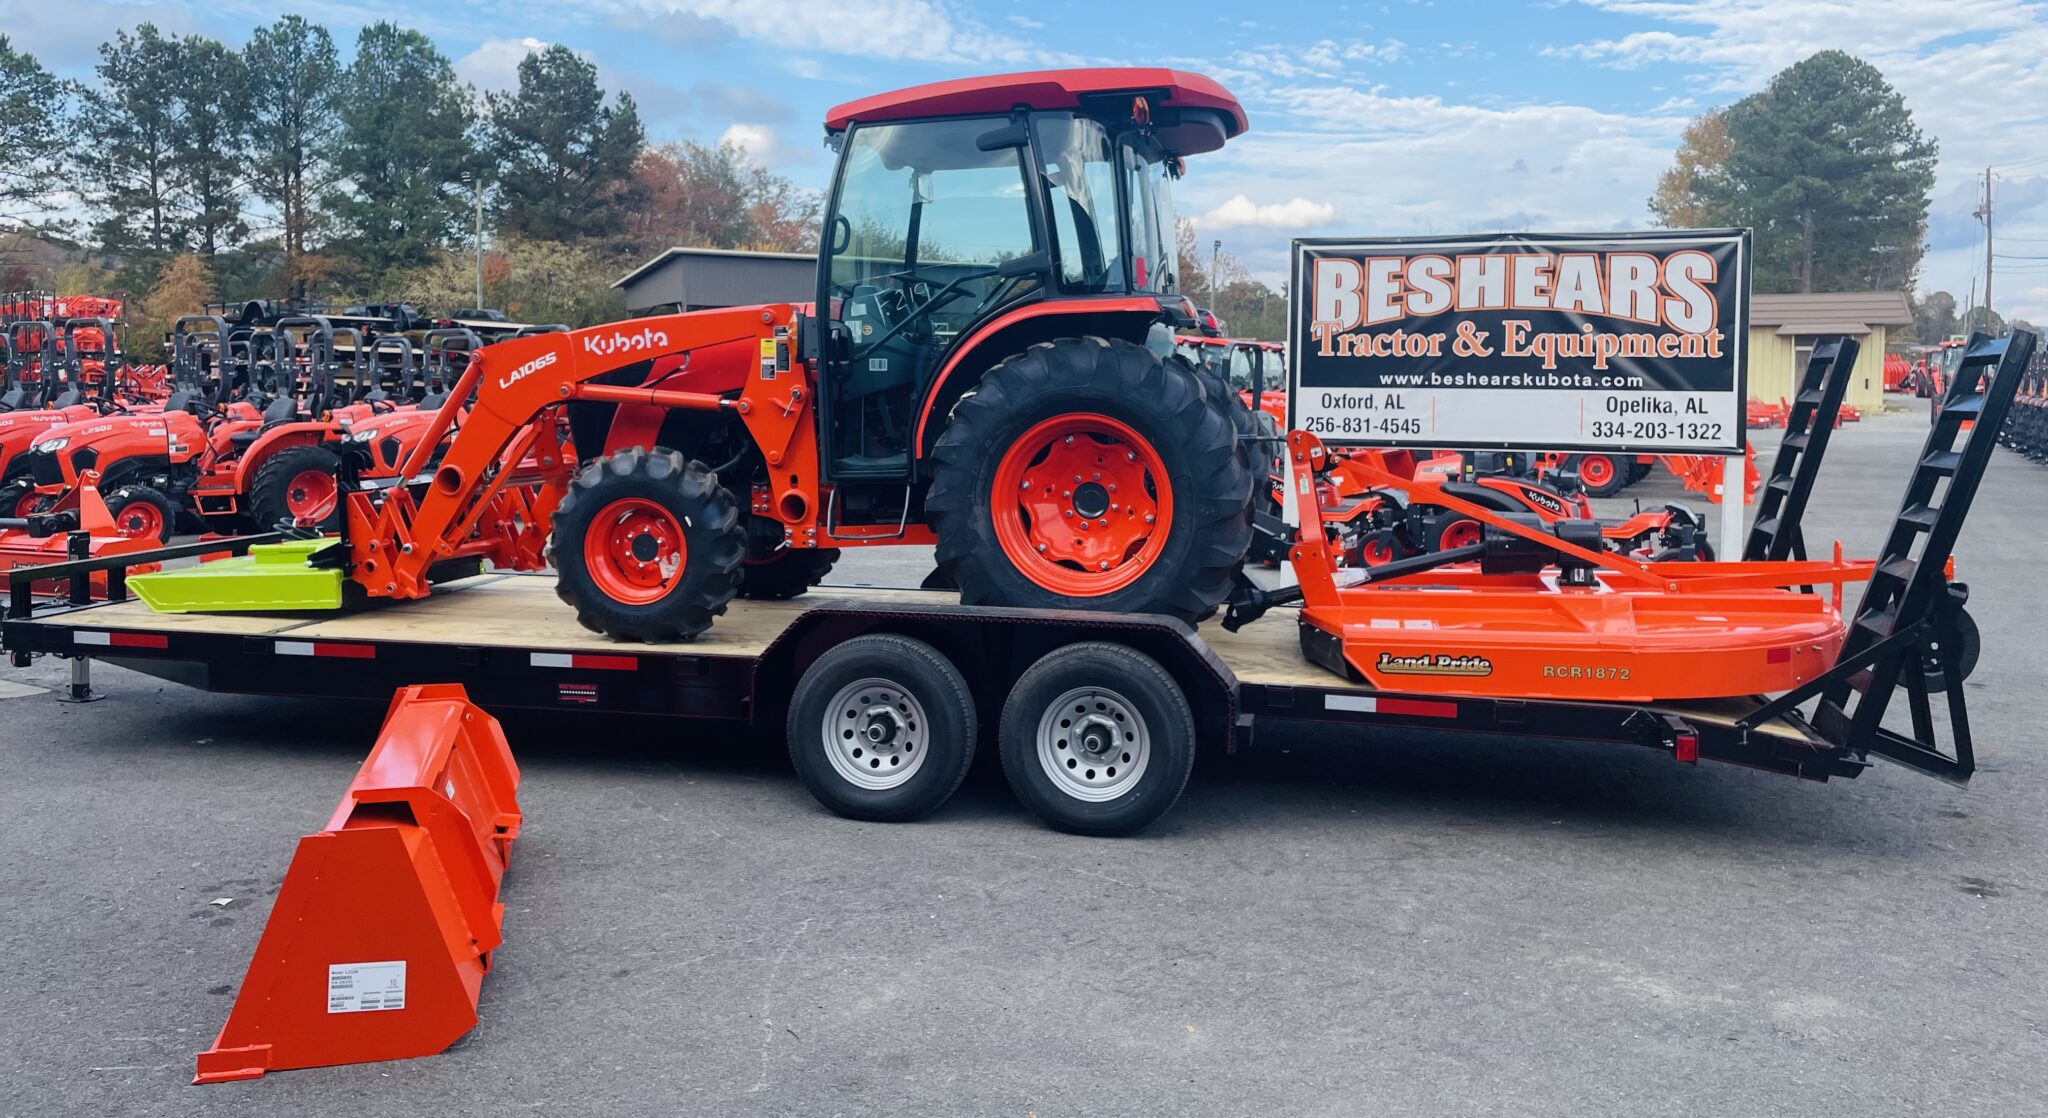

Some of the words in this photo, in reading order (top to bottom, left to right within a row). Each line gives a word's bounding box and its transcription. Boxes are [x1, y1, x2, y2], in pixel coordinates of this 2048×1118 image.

[1312, 249, 1718, 340] BESHEARS
[584, 328, 668, 355] Kubota
[1311, 320, 1446, 357] Tractor
[1452, 320, 1494, 357] &
[1501, 320, 1724, 369] Equipment
[499, 352, 557, 389] LA1065
[1380, 372, 1643, 387] www.beshearskubota.com
[1321, 393, 1378, 411] Oxford,
[1384, 394, 1405, 410] AL
[1606, 396, 1678, 416] Opelika,
[1685, 398, 1708, 414] AL
[1306, 416, 1421, 434] 256-831-4545
[1592, 421, 1722, 440] 334-203-1322
[1528, 490, 1560, 511] Kubota
[1377, 653, 1431, 671] Land
[1435, 655, 1491, 673] Pride
[1543, 665, 1630, 680] RCR1872
